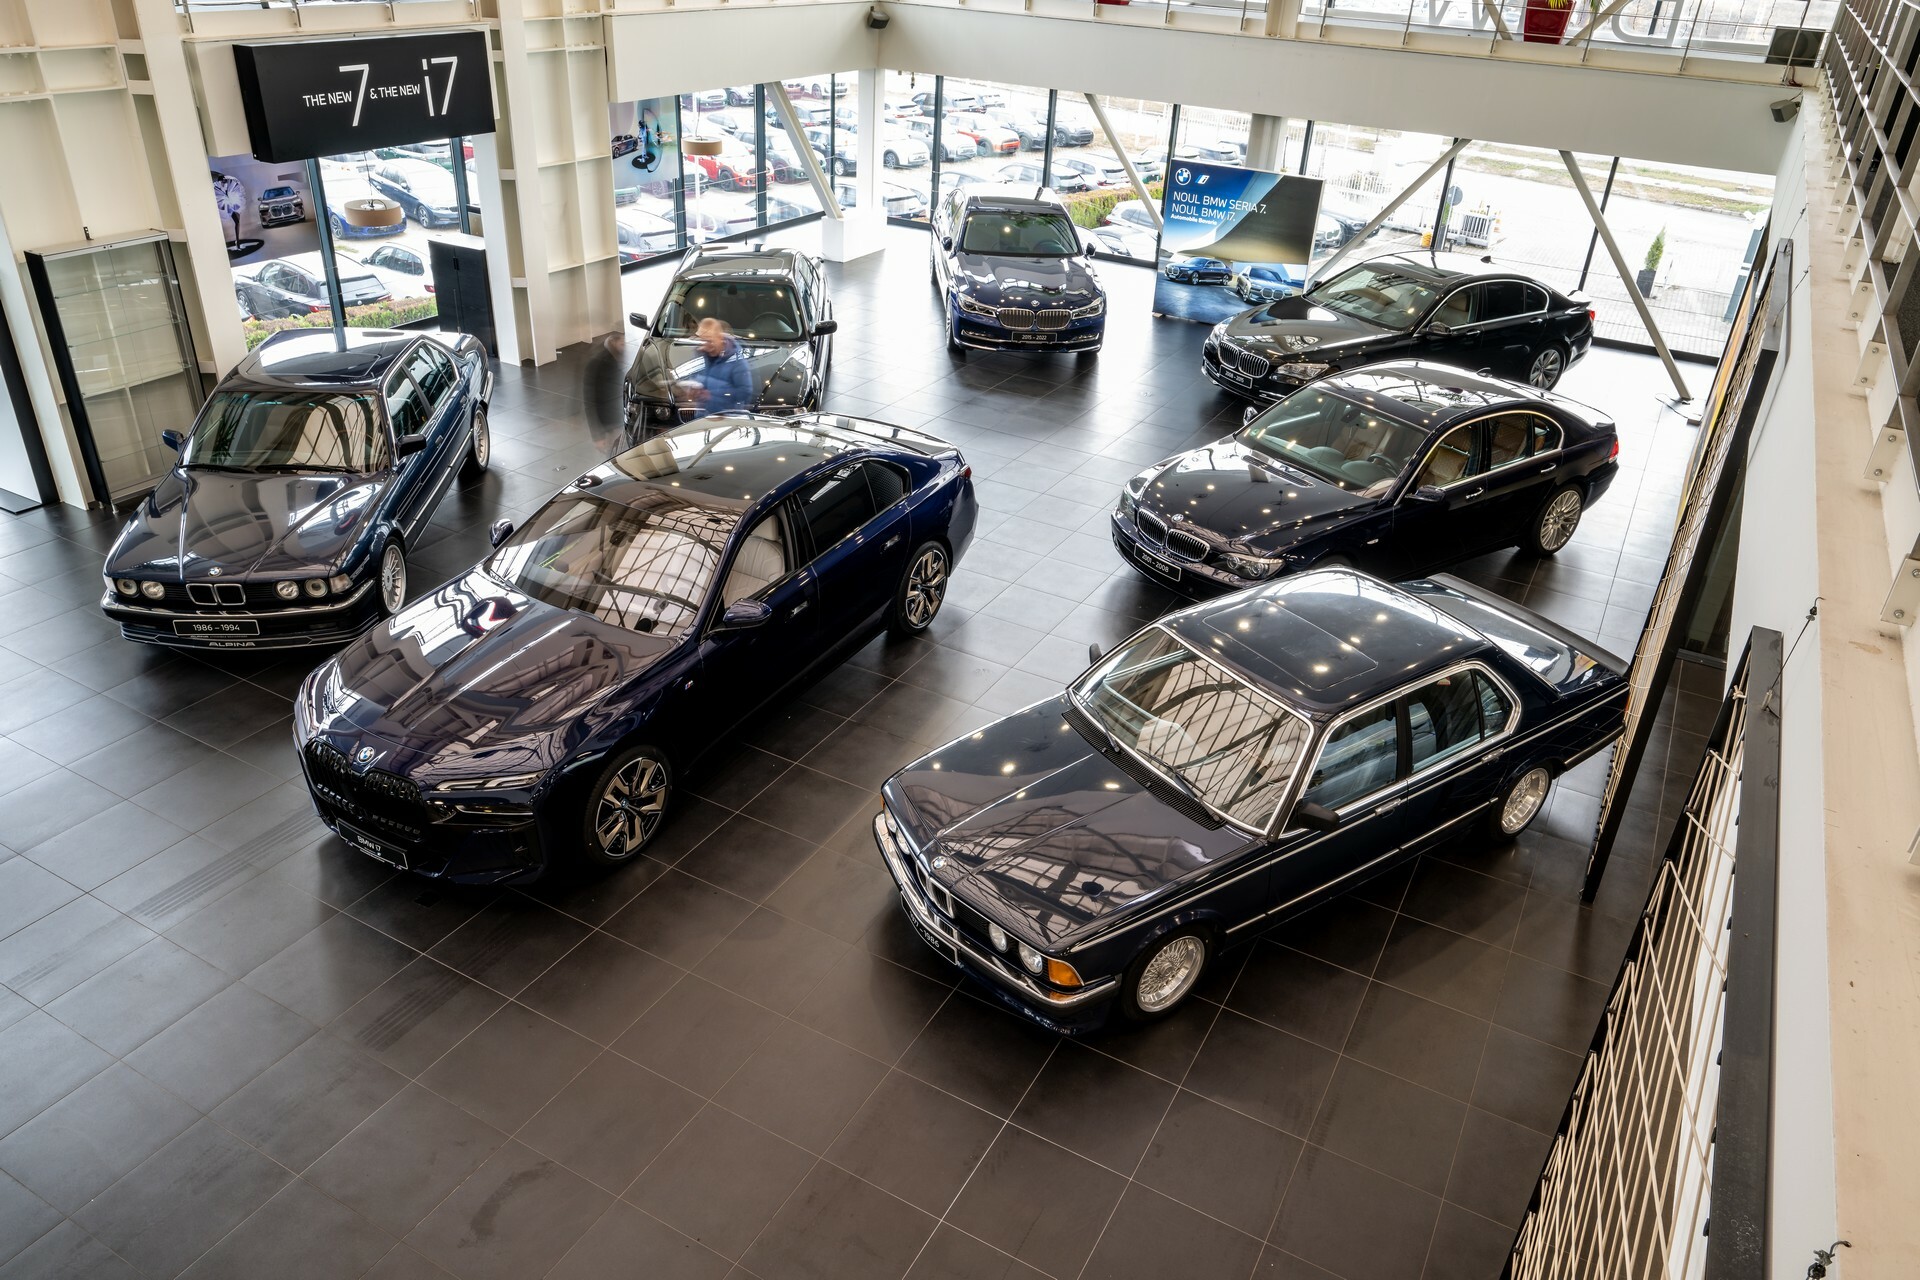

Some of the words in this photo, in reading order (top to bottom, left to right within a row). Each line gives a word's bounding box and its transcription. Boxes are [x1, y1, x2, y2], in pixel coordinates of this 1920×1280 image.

[370, 88, 378, 99] &
[378, 86, 399, 98] THE
[399, 84, 421, 96] NEW
[421, 56, 458, 117] i7
[303, 94, 327, 107] THE
[328, 91, 352, 104] NEW
[339, 64, 369, 127] 7
[1173, 191, 1201, 204] NOUL
[1203, 195, 1228, 208] BMW
[1229, 200, 1258, 213] SERIA
[1259, 203, 1267, 214] 7.
[1170, 214, 1198, 223] Automobile
[1171, 203, 1199, 216] NOUL
[1201, 208, 1225, 220] BMW
[1141, 552, 1152, 563] 2001
[1155, 561, 1170, 573] 2008
[357, 835, 375, 849] BMW
[923, 930, 940, 948] 1986
